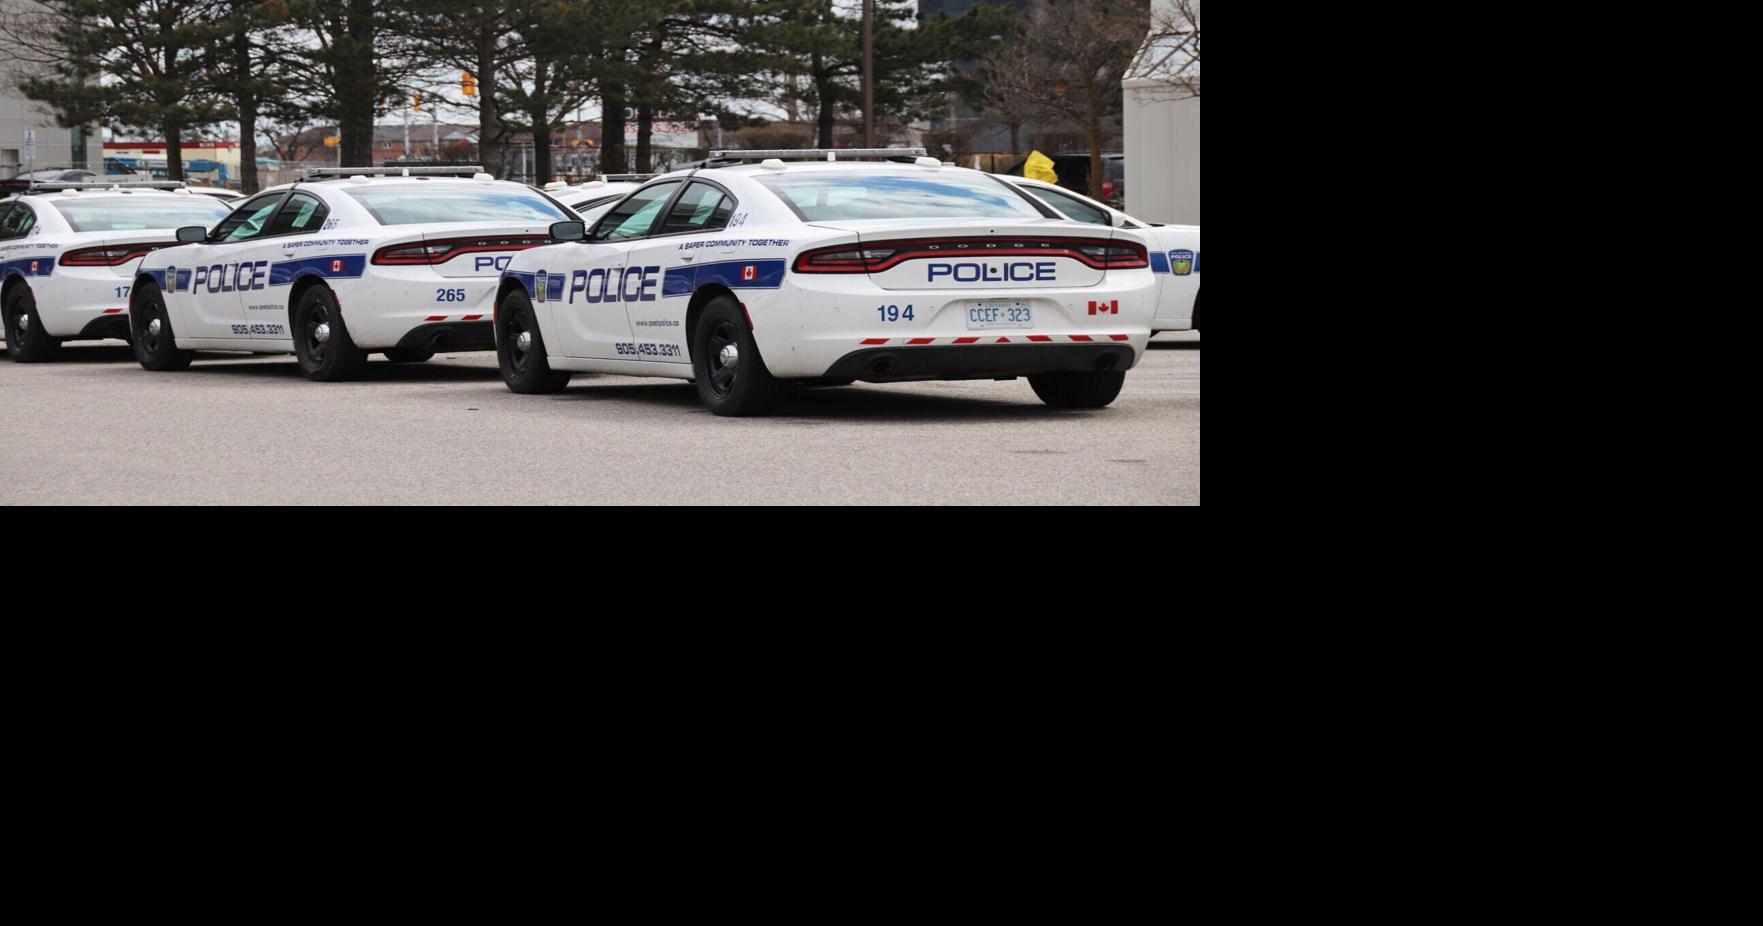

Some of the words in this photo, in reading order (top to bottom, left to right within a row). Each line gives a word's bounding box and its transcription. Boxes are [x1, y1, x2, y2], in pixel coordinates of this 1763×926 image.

[287, 241, 304, 249] SAFER
[685, 241, 704, 250] SAFER
[706, 240, 746, 248] COMMUNITY
[749, 239, 790, 247] TOGETHER
[929, 242, 1051, 250] DODGE
[193, 261, 268, 295] POLICE
[927, 261, 1057, 283] POLICE
[568, 265, 661, 304] POLICE
[436, 288, 465, 302] 265
[877, 304, 915, 322] 194
[969, 308, 999, 322] CCEF
[1007, 307, 1031, 322] 323
[231, 323, 285, 335] 905.453.3311
[615, 342, 682, 357] 905.453.3311
